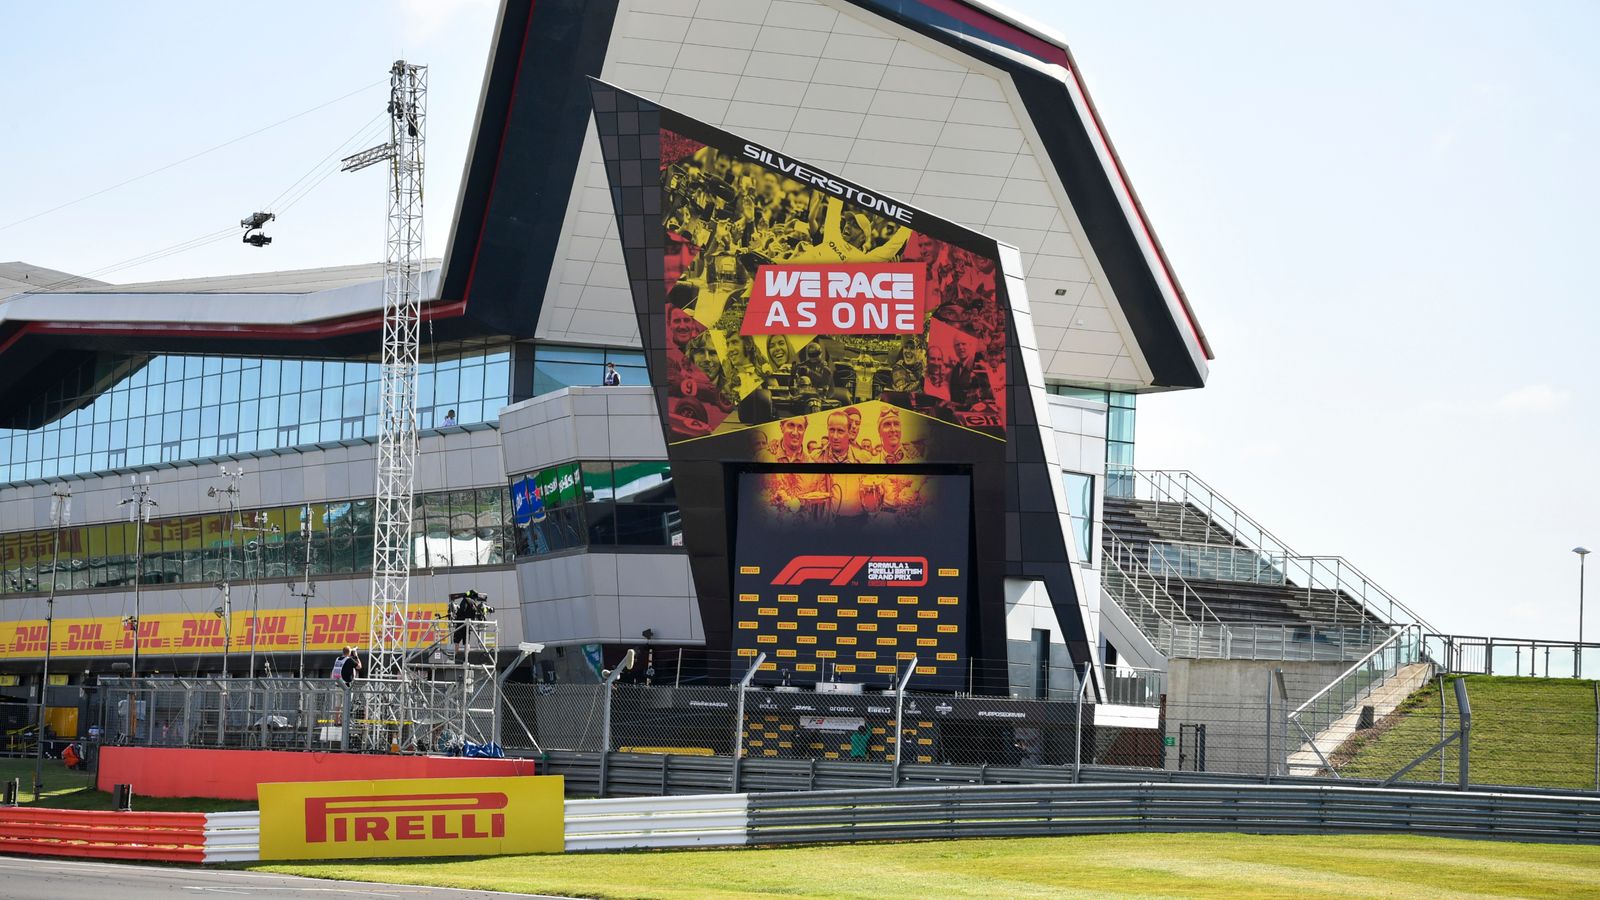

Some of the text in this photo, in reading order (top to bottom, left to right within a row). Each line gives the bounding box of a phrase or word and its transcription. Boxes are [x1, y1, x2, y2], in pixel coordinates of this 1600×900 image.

[743, 143, 914, 224] SILVERSTONE
[765, 271, 914, 300] WE RACE
[765, 301, 915, 331] AS ONE
[16, 626, 49, 651] DHL
[68, 624, 104, 650] DHL
[123, 621, 162, 648] DHL
[182, 619, 226, 647] DHL
[245, 617, 289, 644] DHL
[311, 614, 359, 643] DHL
[305, 792, 508, 842] PIRELLI
